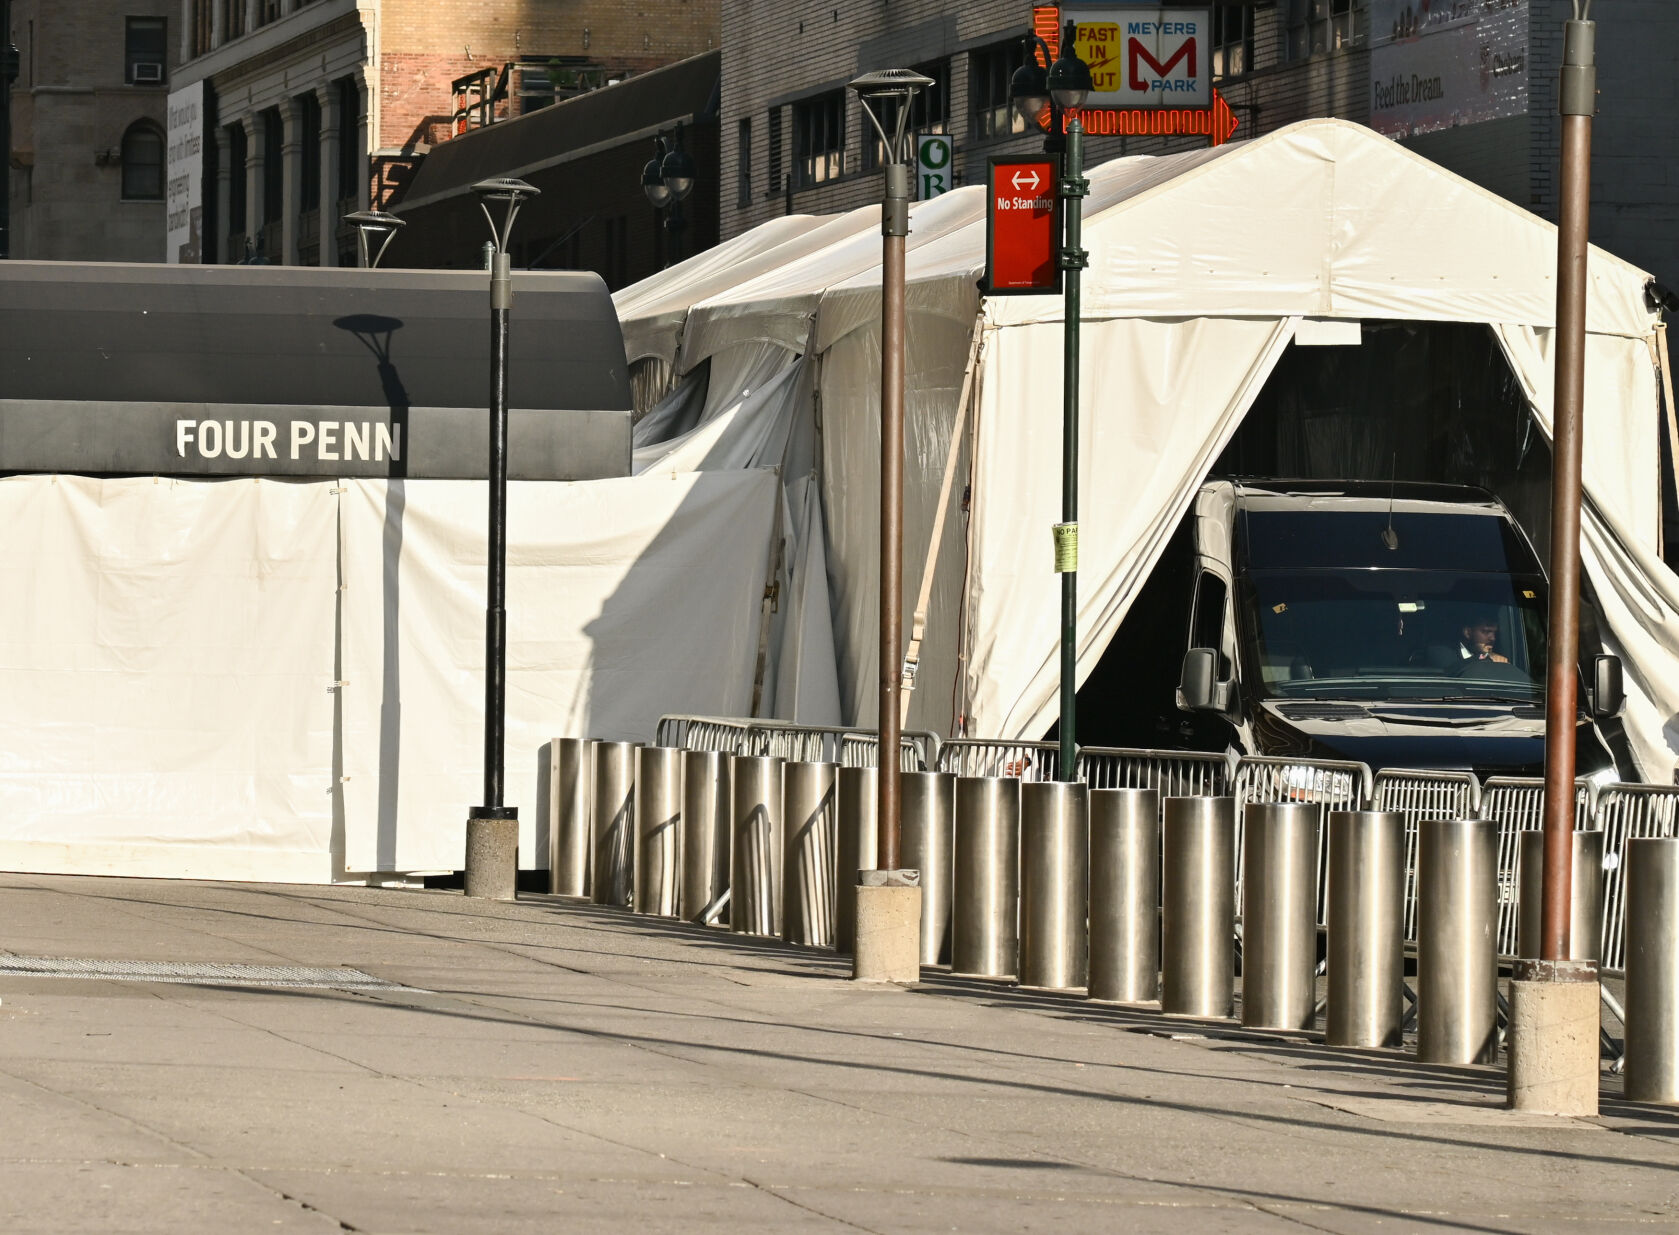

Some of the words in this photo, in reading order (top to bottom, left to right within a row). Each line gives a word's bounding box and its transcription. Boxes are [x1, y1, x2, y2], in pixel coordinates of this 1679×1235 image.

[1078, 28, 1118, 42] FAST
[1127, 22, 1197, 35] MEYERS
[1089, 45, 1106, 59] IN
[1092, 72, 1117, 87] UT
[1151, 79, 1197, 92] PARK
[1375, 76, 1395, 110] Feed
[1396, 74, 1410, 106] the
[1411, 73, 1445, 104] Dream.
[997, 197, 1011, 210] No
[1012, 195, 1053, 212] Standing
[176, 419, 278, 459] FOUR
[290, 420, 401, 462] PENN
